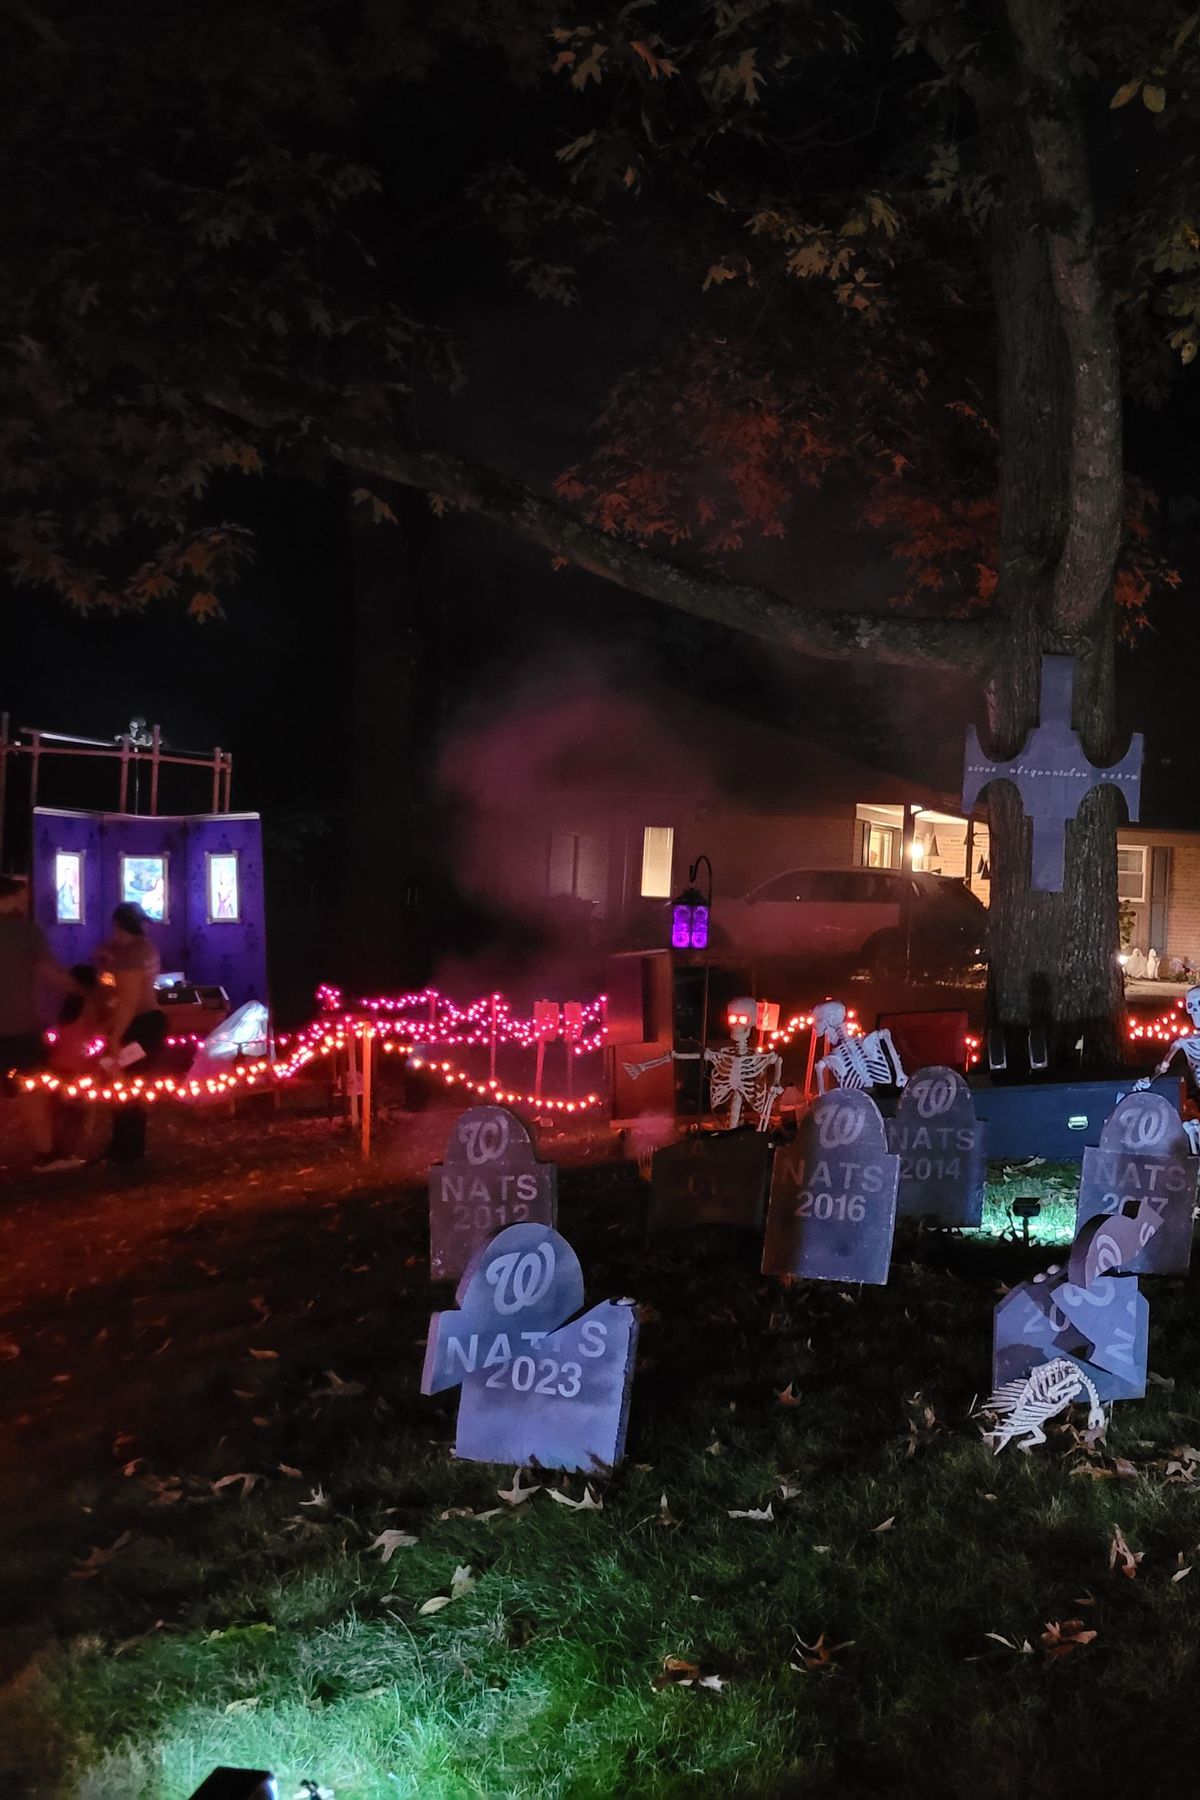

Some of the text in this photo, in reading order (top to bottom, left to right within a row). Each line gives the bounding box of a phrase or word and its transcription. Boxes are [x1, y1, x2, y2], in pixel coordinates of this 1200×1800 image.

[889, 1126, 975, 1151] NATS
[781, 1158, 883, 1192] NATS
[899, 1157, 961, 1180] 2014
[441, 1174, 538, 1202] NATS
[453, 1203, 530, 1230] 2012
[795, 1193, 867, 1222] 2016
[486, 1242, 556, 1315] W
[485, 1355, 583, 1398] 2023
